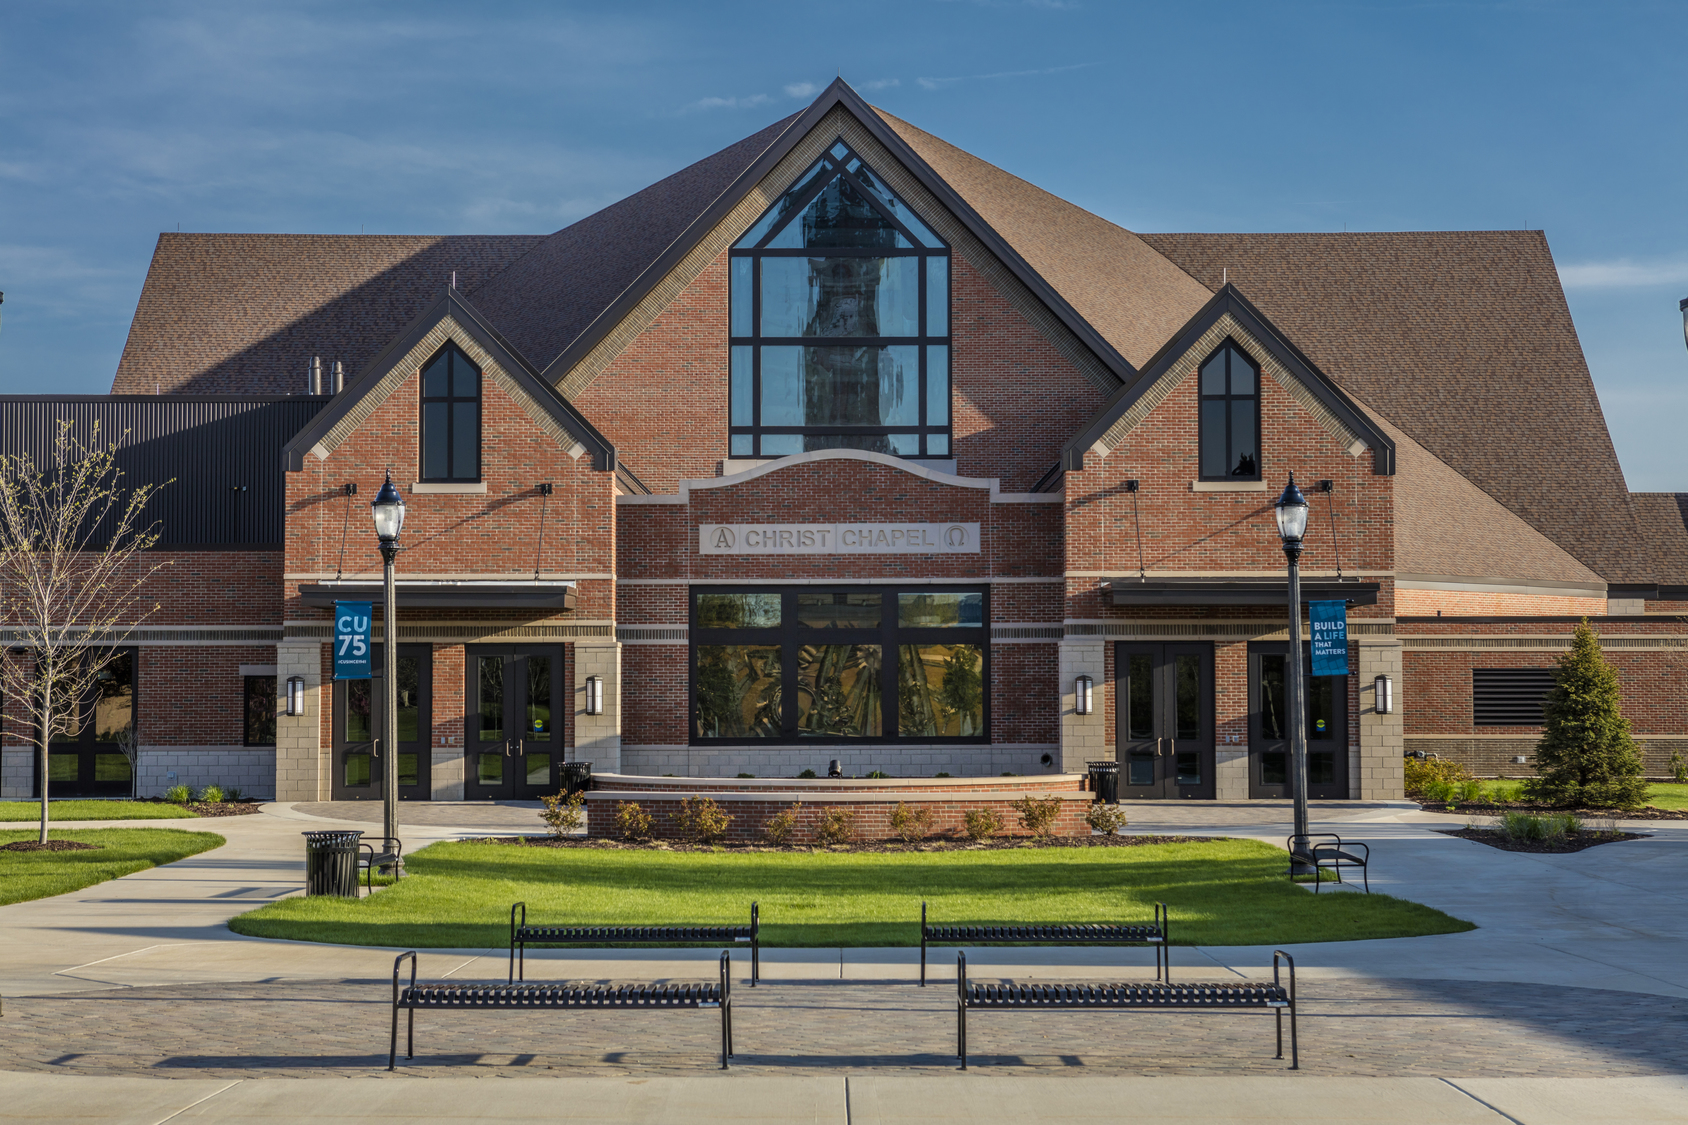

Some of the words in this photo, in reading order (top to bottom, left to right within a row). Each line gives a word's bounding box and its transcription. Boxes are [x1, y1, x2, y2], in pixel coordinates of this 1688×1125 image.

[714, 528, 731, 548] A
[745, 529, 831, 548] CHRIST
[841, 529, 935, 547] CHAPEL
[338, 616, 368, 633] CU
[1314, 621, 1345, 631] BUILD
[1314, 632, 1322, 641] A
[1323, 631, 1345, 640] LIFE
[338, 634, 367, 656] 75
